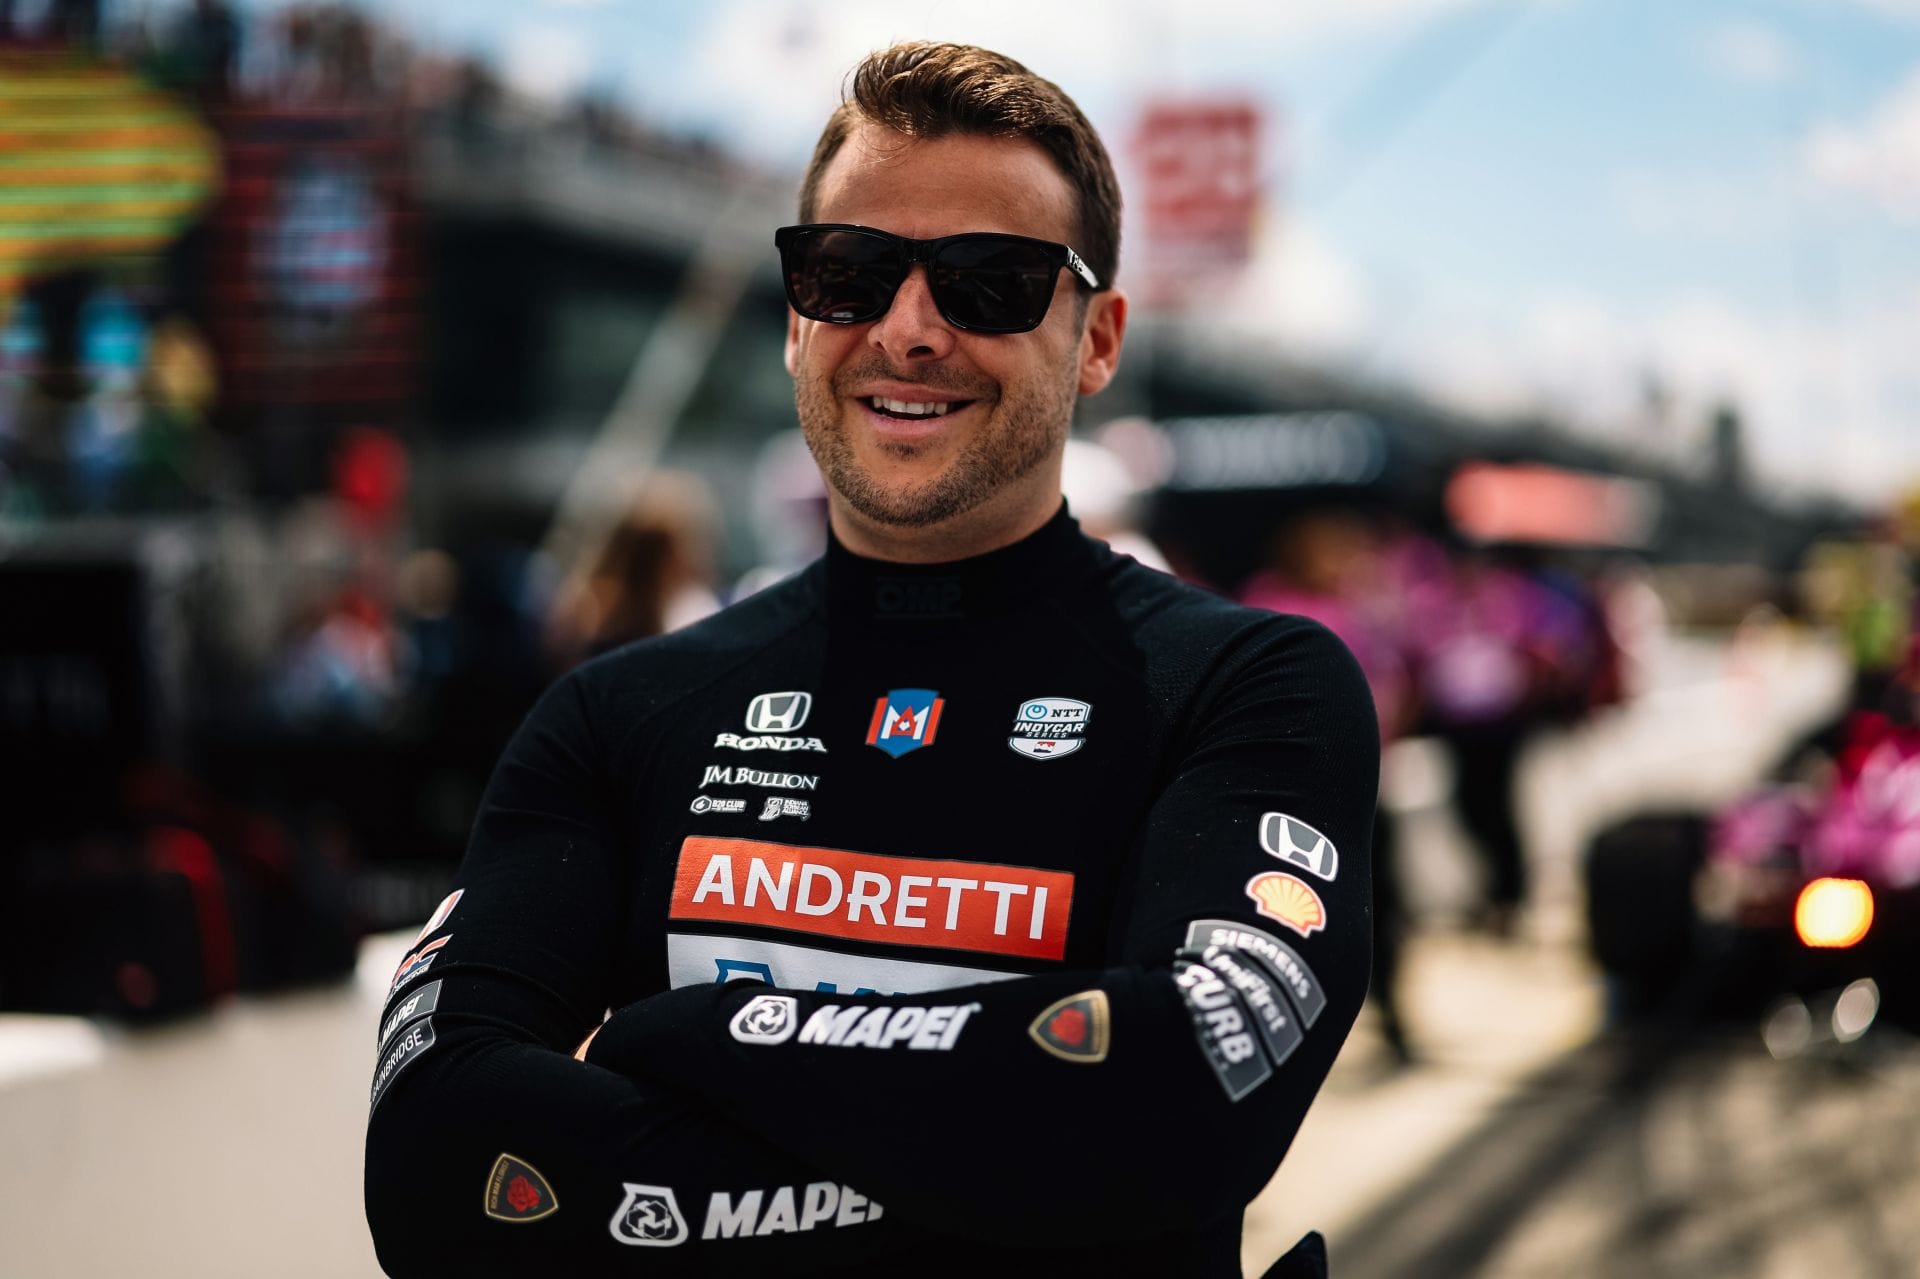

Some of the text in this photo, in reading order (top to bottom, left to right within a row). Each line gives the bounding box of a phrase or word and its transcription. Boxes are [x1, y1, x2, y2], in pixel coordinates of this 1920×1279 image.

[1050, 708, 1084, 718] NTT
[1012, 721, 1086, 733] INDYCAR
[713, 732, 828, 753] HONDA
[698, 764, 820, 791] JM BULLION
[726, 800, 745, 809] CLUB
[692, 854, 1049, 941] ANDRETTI
[1209, 928, 1312, 999] SIEMENS
[797, 1002, 982, 1051] MAPEI
[1176, 964, 1255, 1064] CURB
